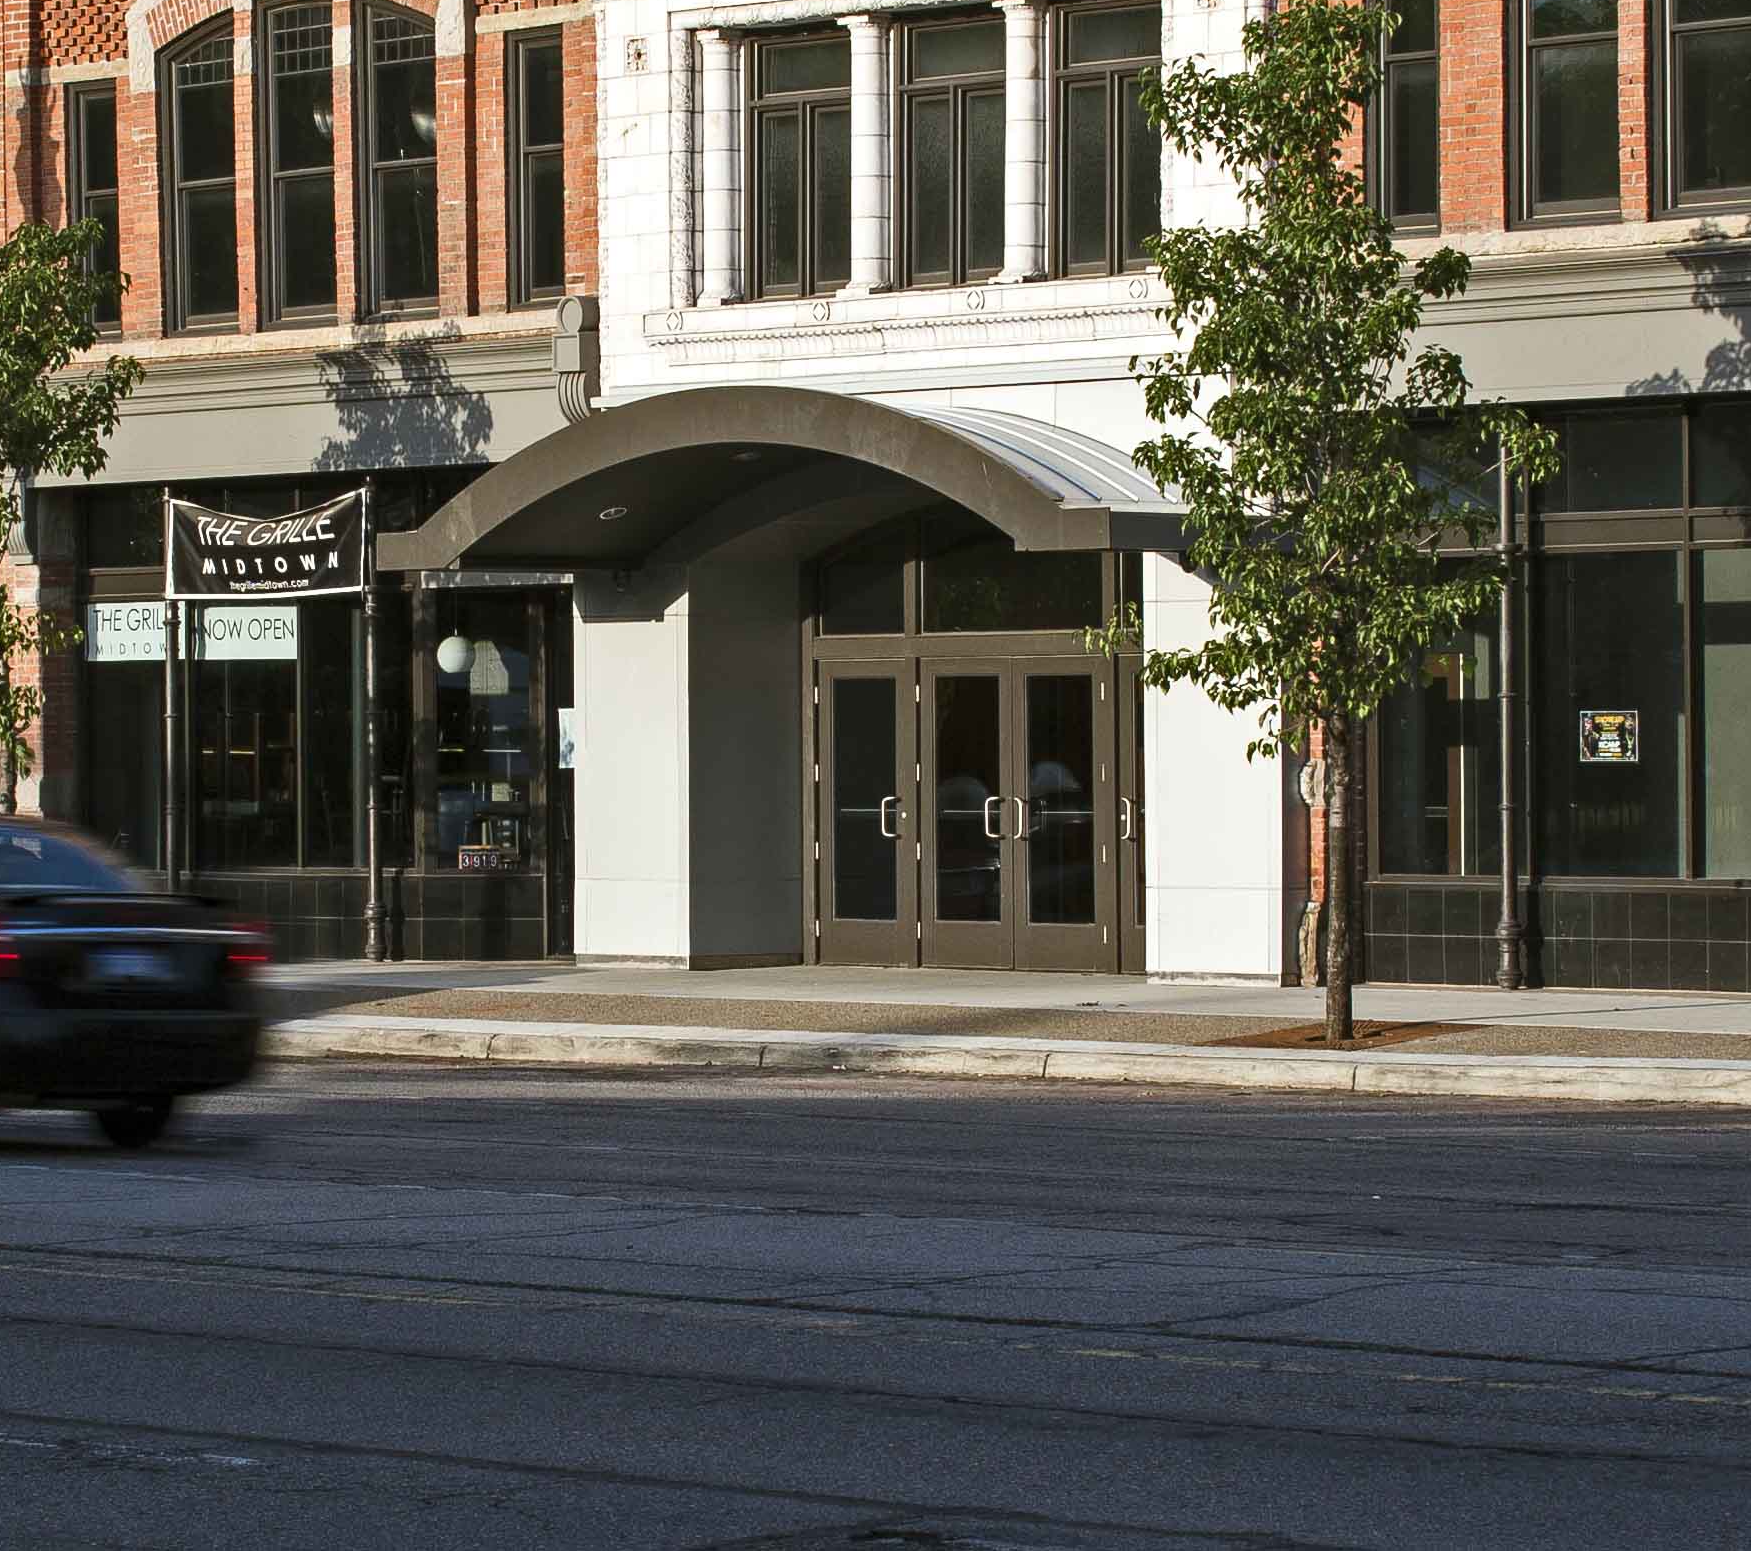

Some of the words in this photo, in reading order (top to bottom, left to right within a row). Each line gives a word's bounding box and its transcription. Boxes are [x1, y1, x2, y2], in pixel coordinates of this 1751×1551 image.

[198, 516, 248, 546] THE
[246, 512, 336, 546] GRILLE
[201, 551, 339, 575] MIDTOWN
[93, 609, 122, 631] THE
[127, 608, 164, 631] GRIL
[200, 618, 243, 640] NOW
[248, 618, 295, 640] OPEN
